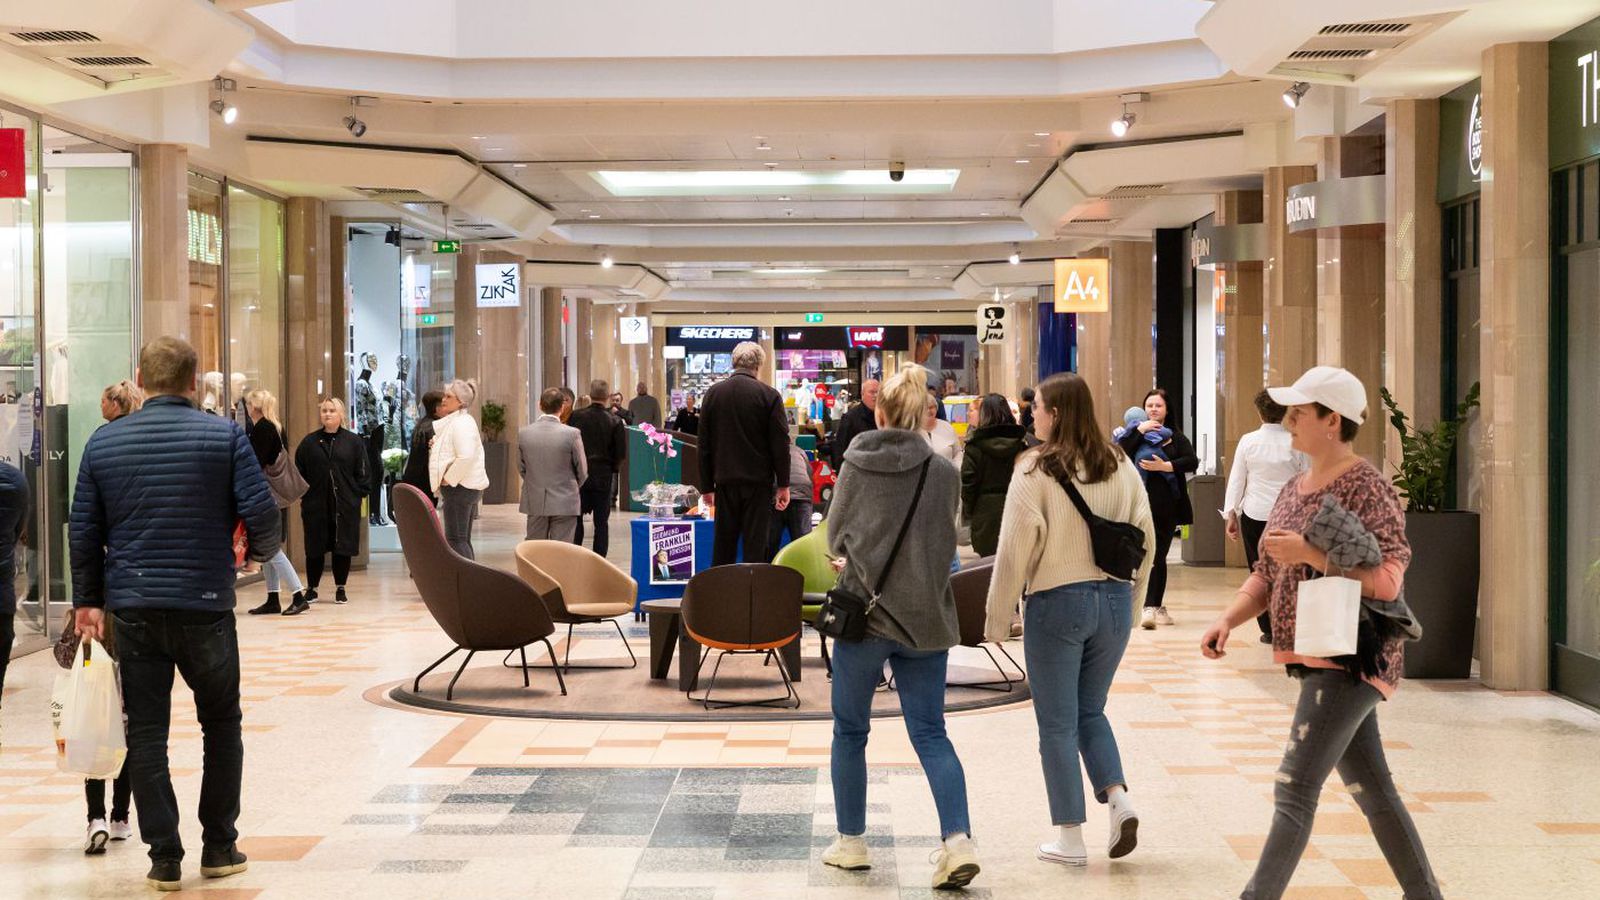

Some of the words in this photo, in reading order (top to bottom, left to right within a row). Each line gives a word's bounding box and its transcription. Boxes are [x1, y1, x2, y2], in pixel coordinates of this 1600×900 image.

[1472, 130, 1481, 146] BOD
[1063, 270, 1099, 300] A4
[679, 327, 754, 339] SKECHERS
[28, 450, 65, 460] OLY
